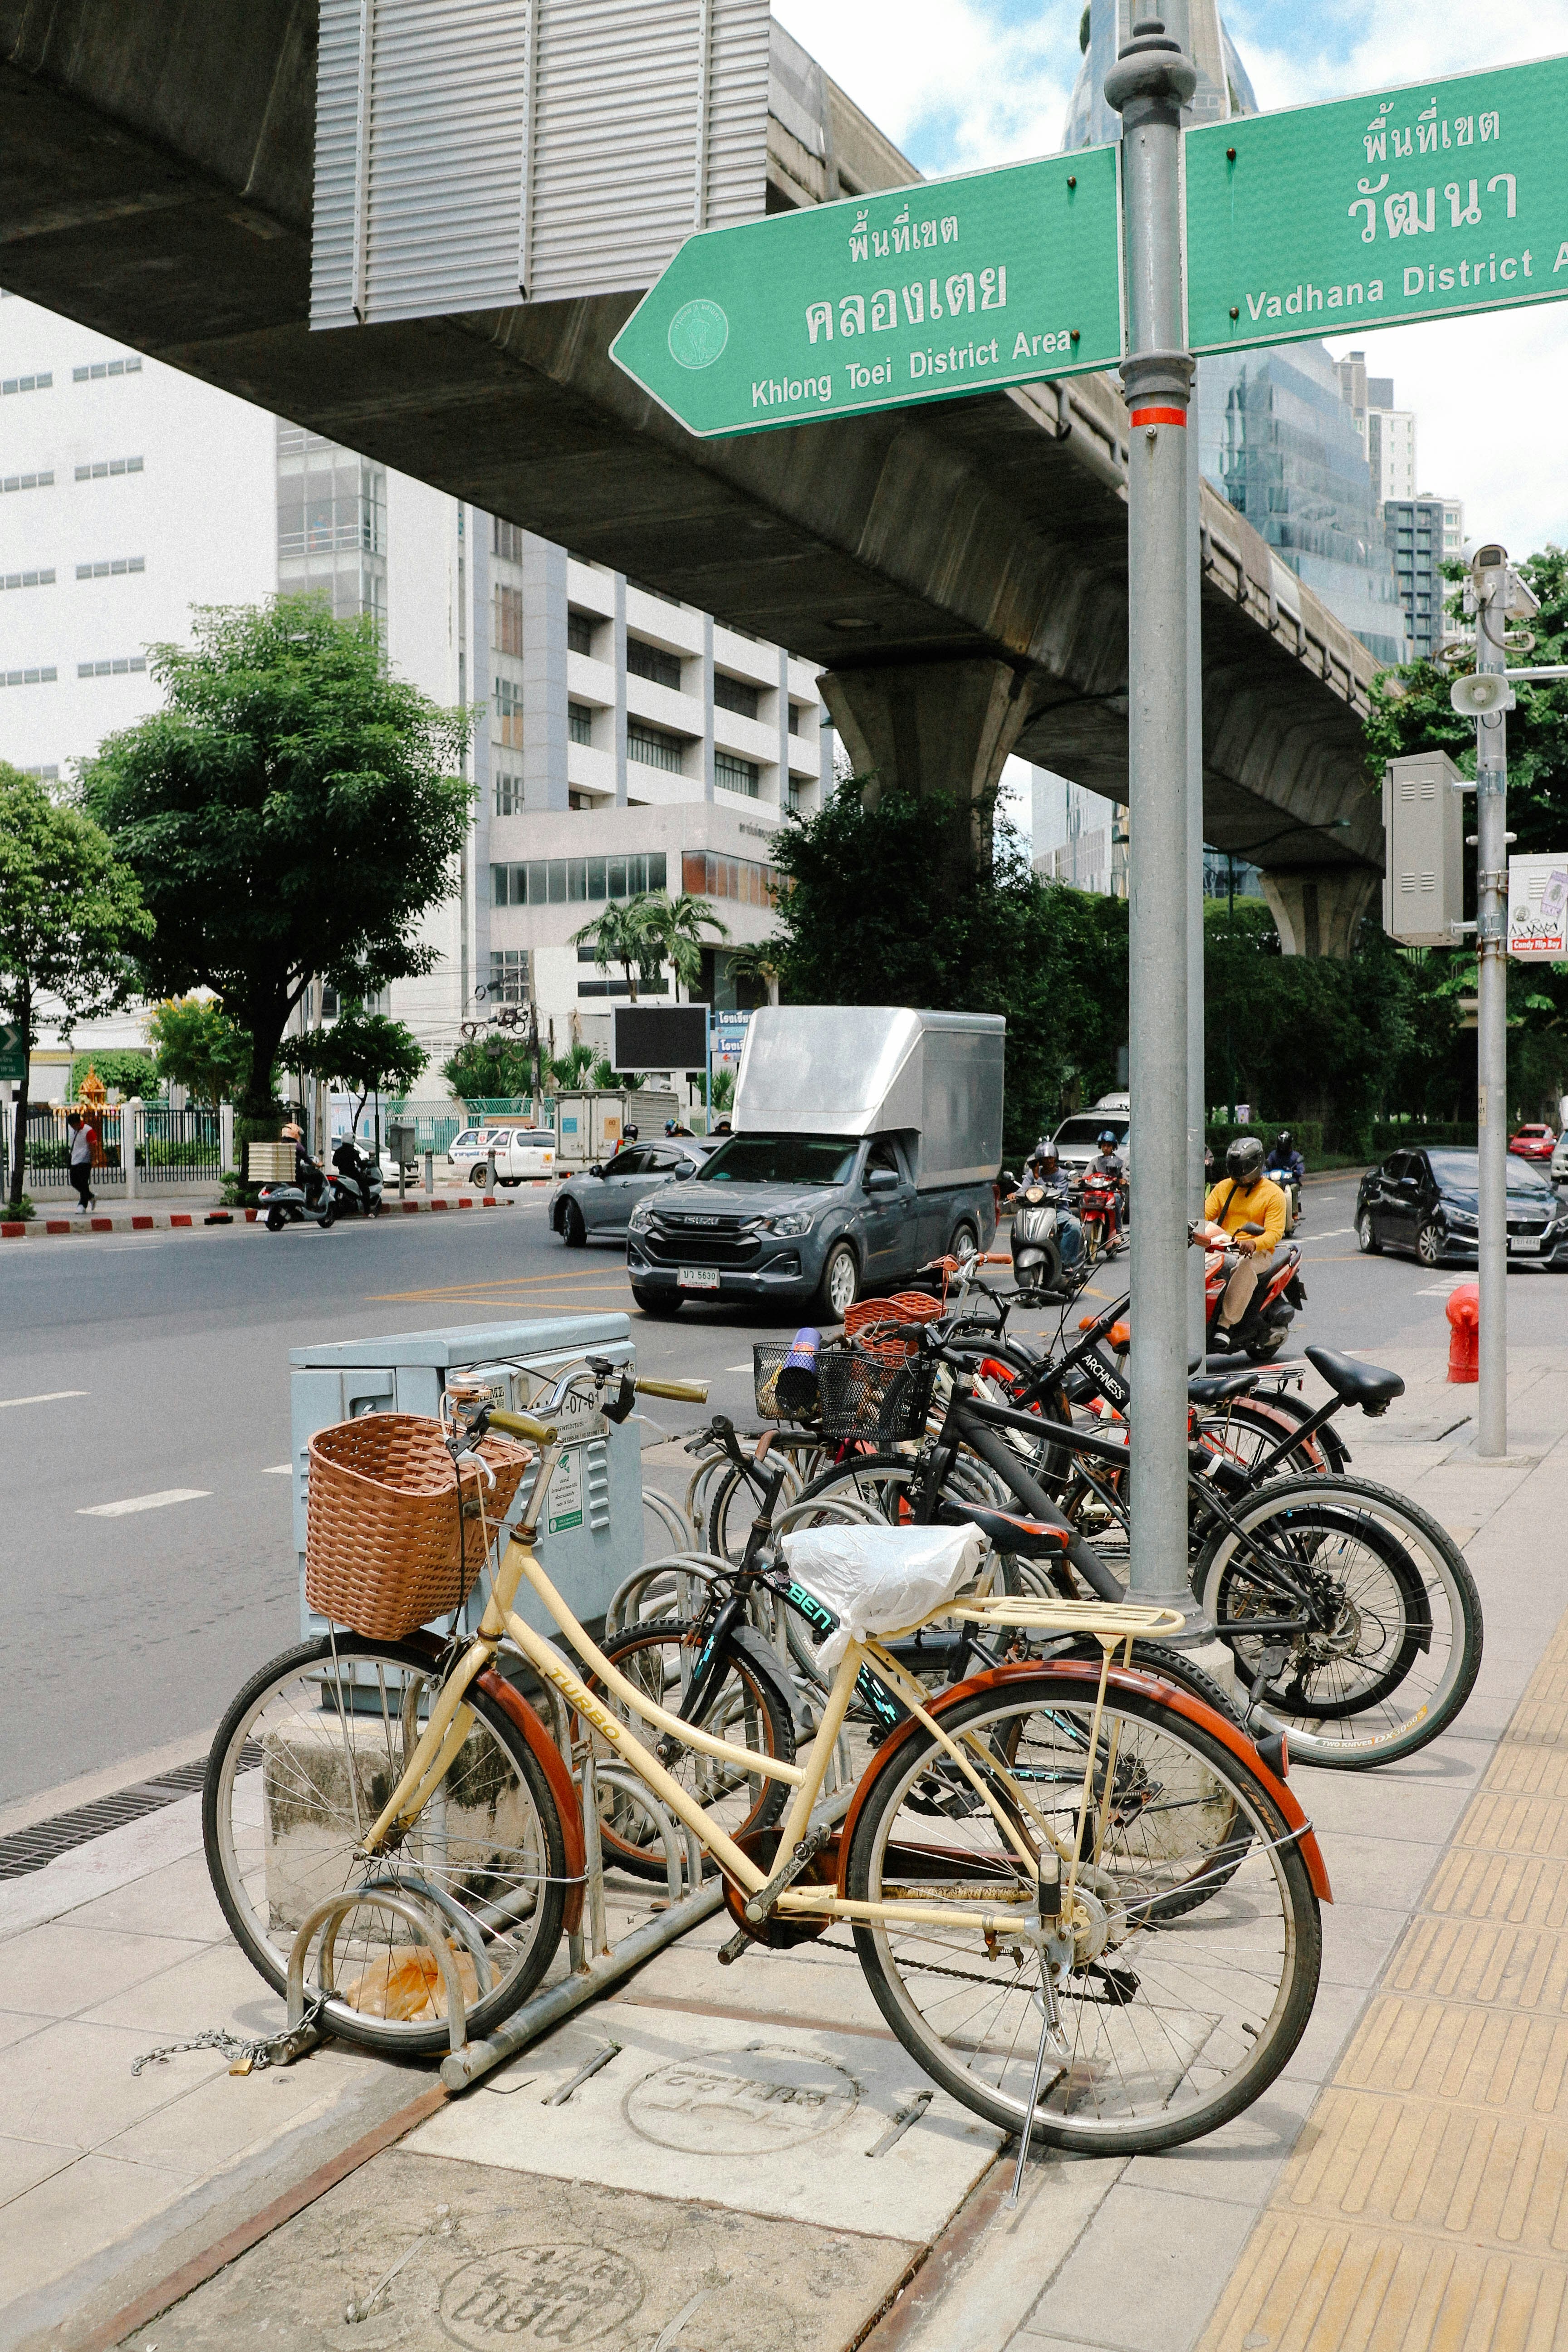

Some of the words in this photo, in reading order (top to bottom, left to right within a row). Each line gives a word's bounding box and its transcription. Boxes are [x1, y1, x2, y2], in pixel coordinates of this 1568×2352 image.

[1363, 97, 1500, 164] พื้นที่เขต
[848, 203, 959, 263] พื้นที่เขต
[1348, 172, 1517, 244] วัฒนา
[805, 264, 1008, 345] คลองเตย
[1245, 279, 1384, 322] Vadhana
[1403, 248, 1534, 297] District
[1552, 241, 1568, 274] A
[751, 372, 833, 409] Khlong
[845, 357, 892, 391] Toei
[910, 338, 999, 379] District
[1012, 329, 1071, 360] Area
[1514, 940, 1534, 950] Candy
[1535, 940, 1547, 949] Flip
[719, 1010, 752, 1024] โรงเรีย
[698, 1271, 715, 1280] 5630
[1082, 1354, 1126, 1400] ARCHNESS
[788, 1583, 838, 1636] BEN
[802, 1636, 813, 1651] TWO
[551, 1667, 620, 1740] TURBO
[1341, 1740, 1372, 1748] KNIVES
